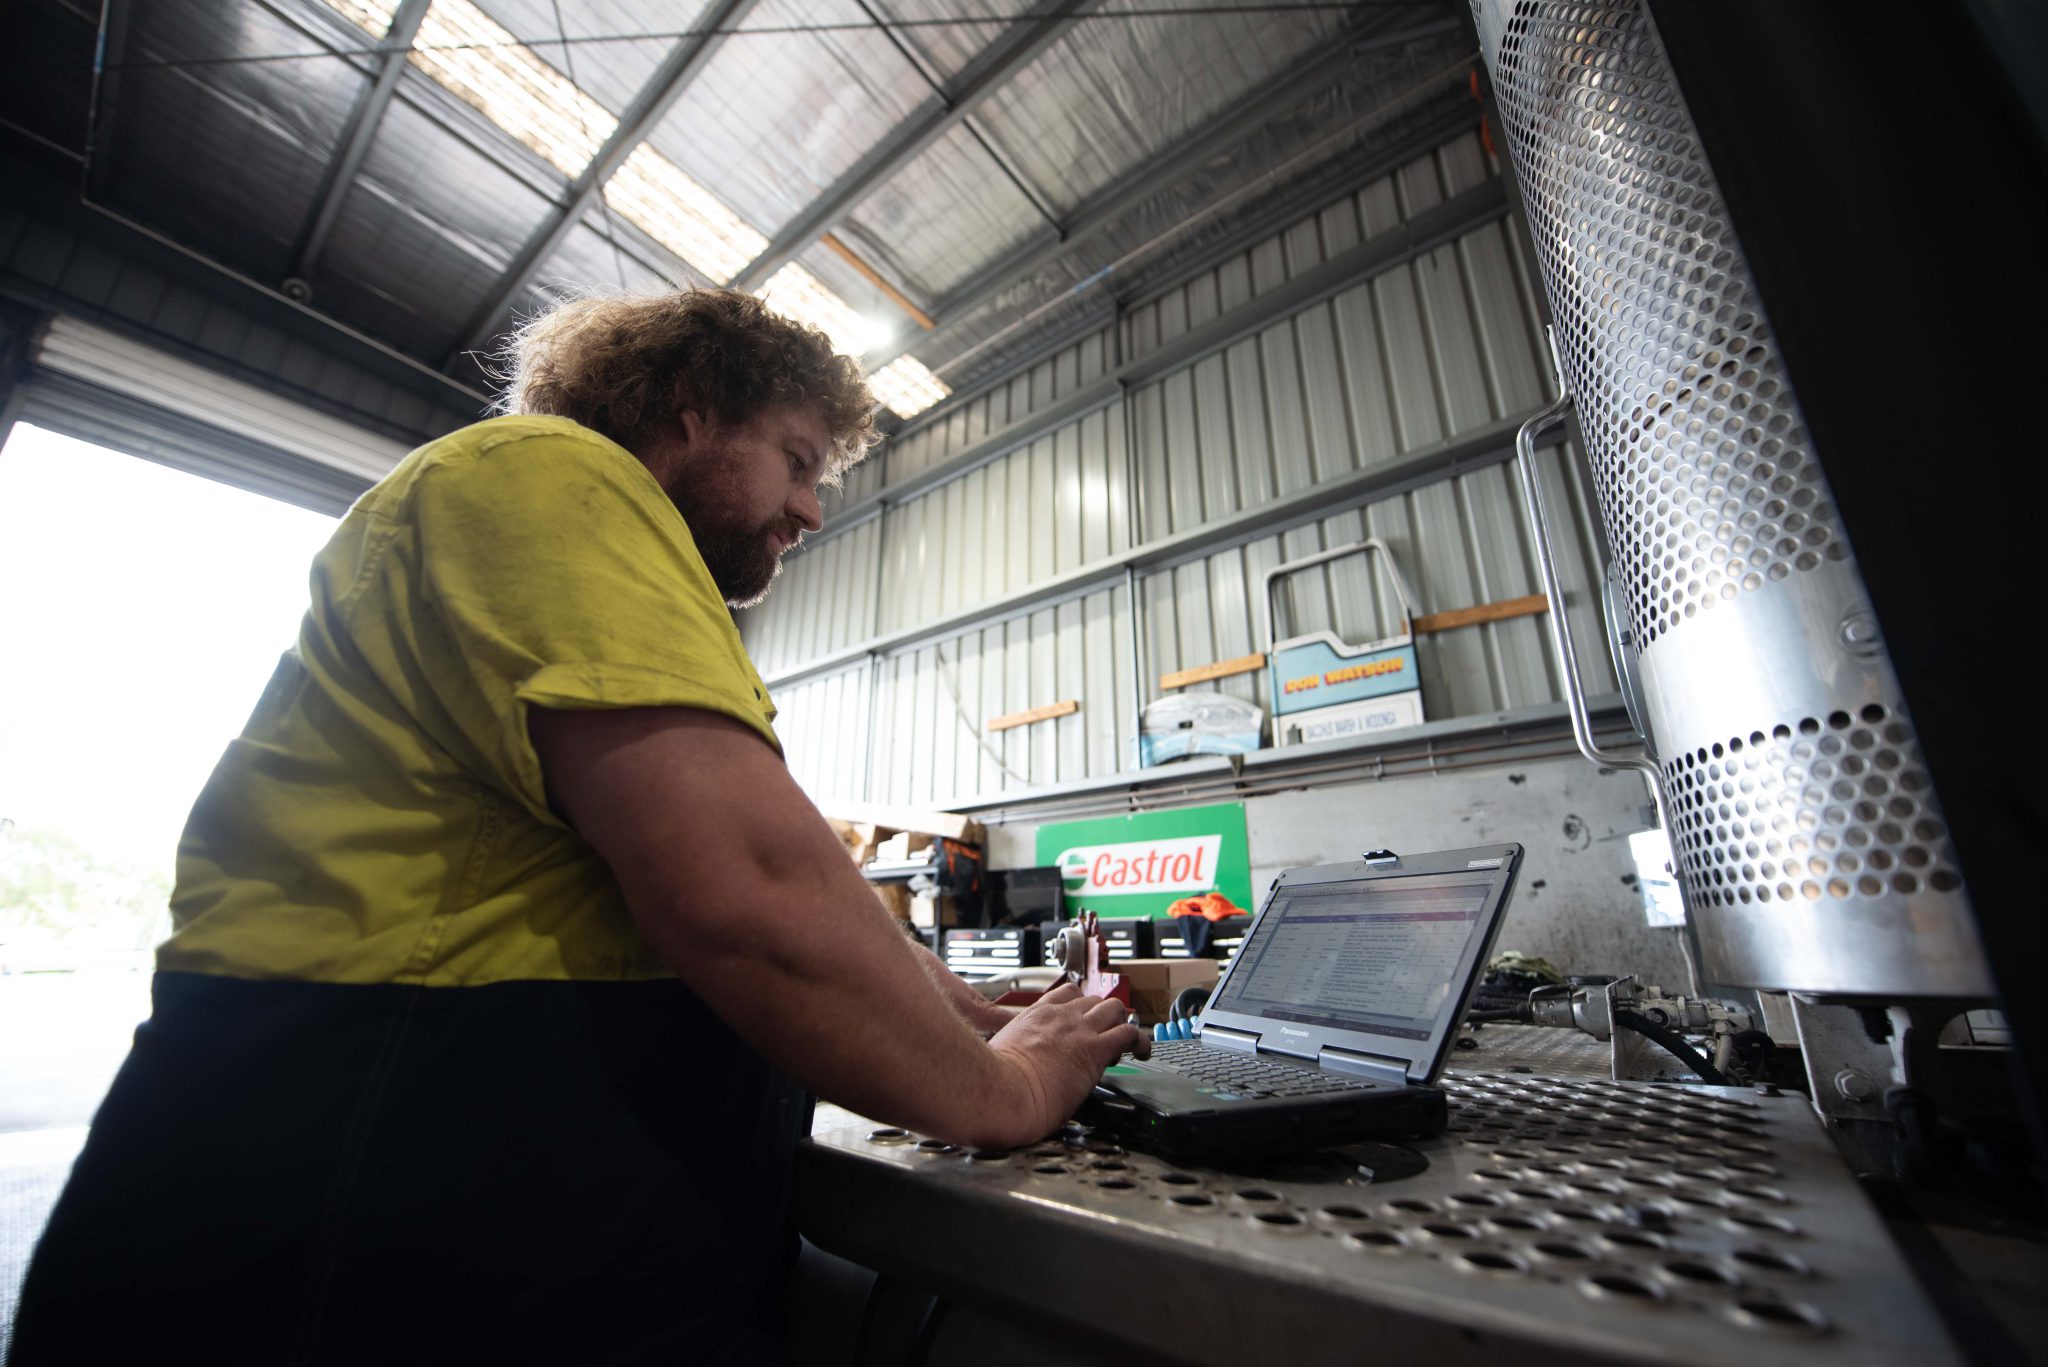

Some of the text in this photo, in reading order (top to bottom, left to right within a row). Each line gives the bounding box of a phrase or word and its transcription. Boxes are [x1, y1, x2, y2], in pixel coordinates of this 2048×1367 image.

[1284, 658, 1403, 693] DON WATSON
[1091, 845, 1204, 887] Castrol
[1280, 1026, 1310, 1038] Panasonic
